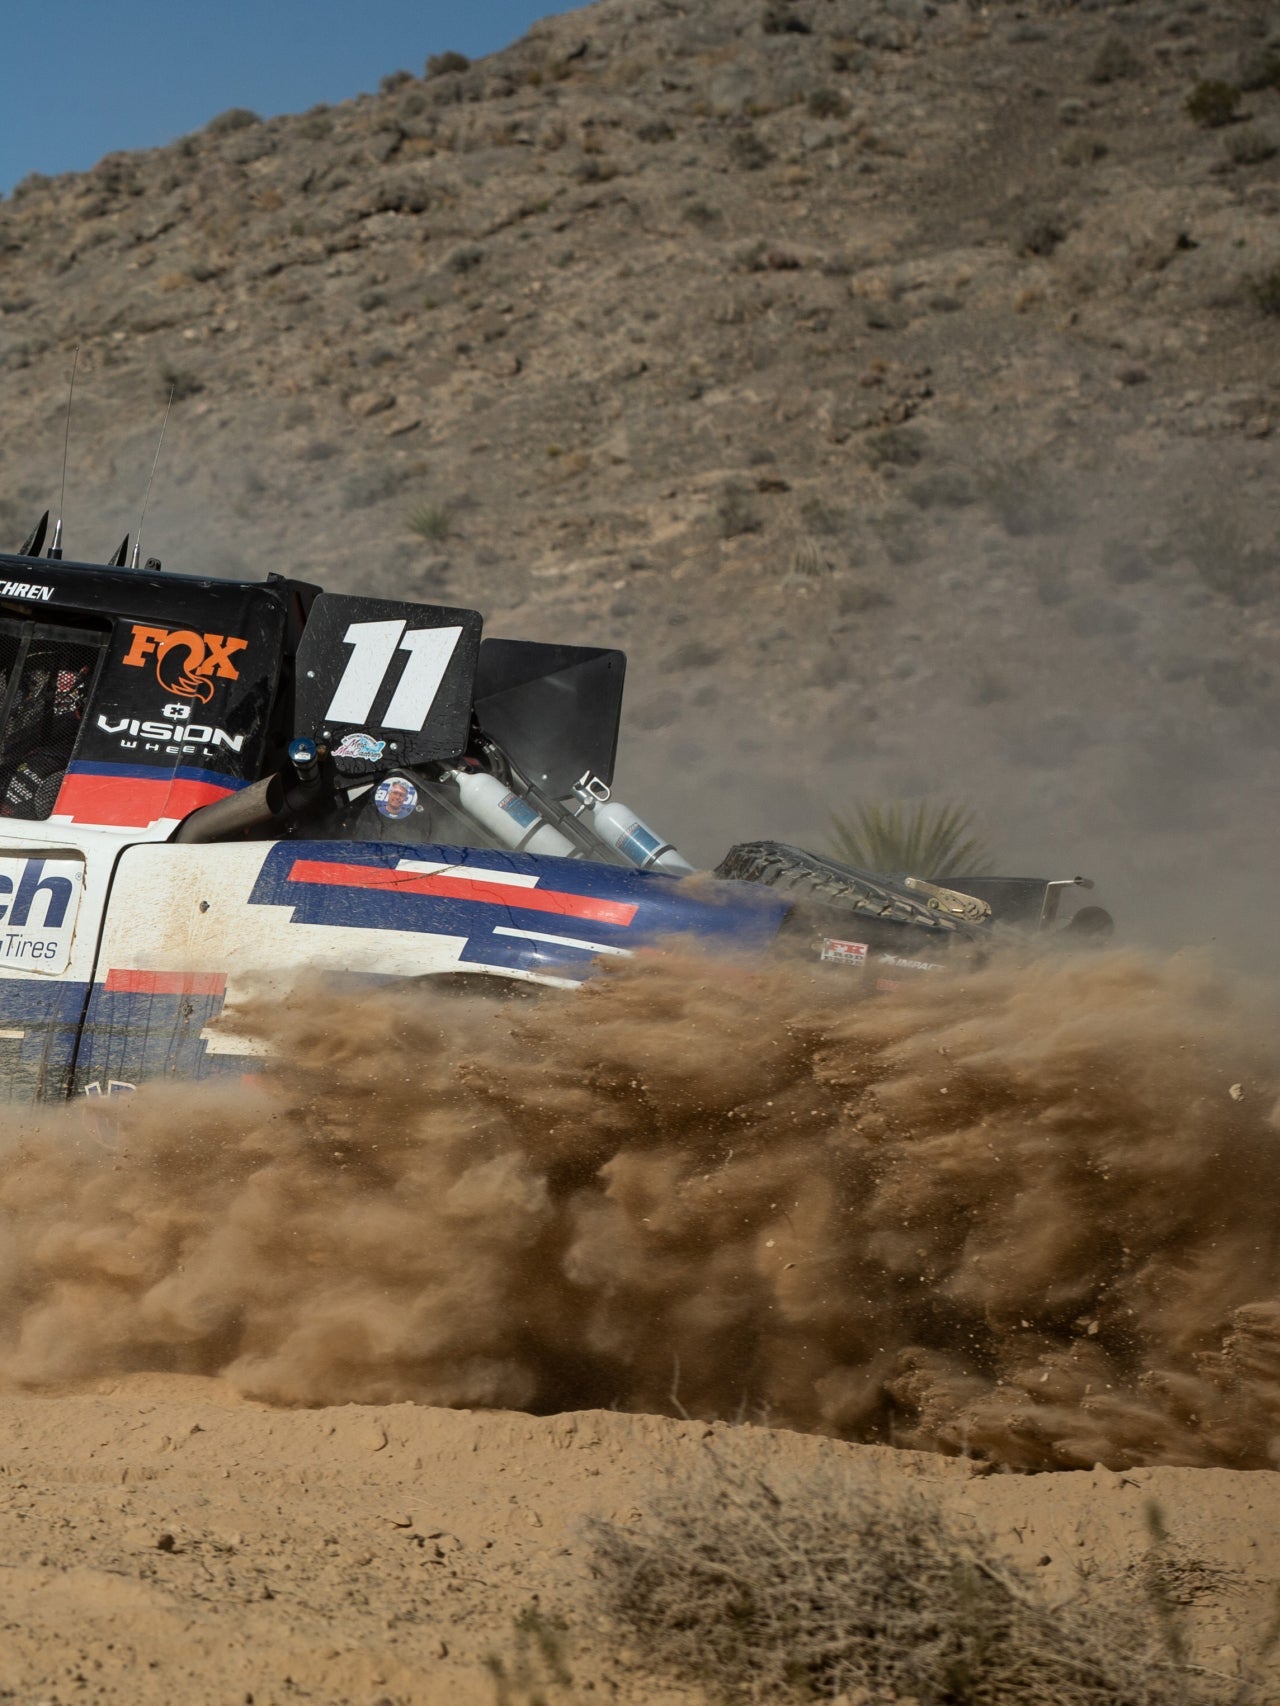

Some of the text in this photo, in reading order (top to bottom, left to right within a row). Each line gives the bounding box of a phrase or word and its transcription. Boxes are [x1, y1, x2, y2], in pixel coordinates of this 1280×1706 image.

[122, 625, 248, 704] FOX
[324, 619, 463, 732] 11
[97, 714, 244, 752] VISION
[120, 739, 214, 757] WHEEL
[5, 933, 58, 959] Tires
